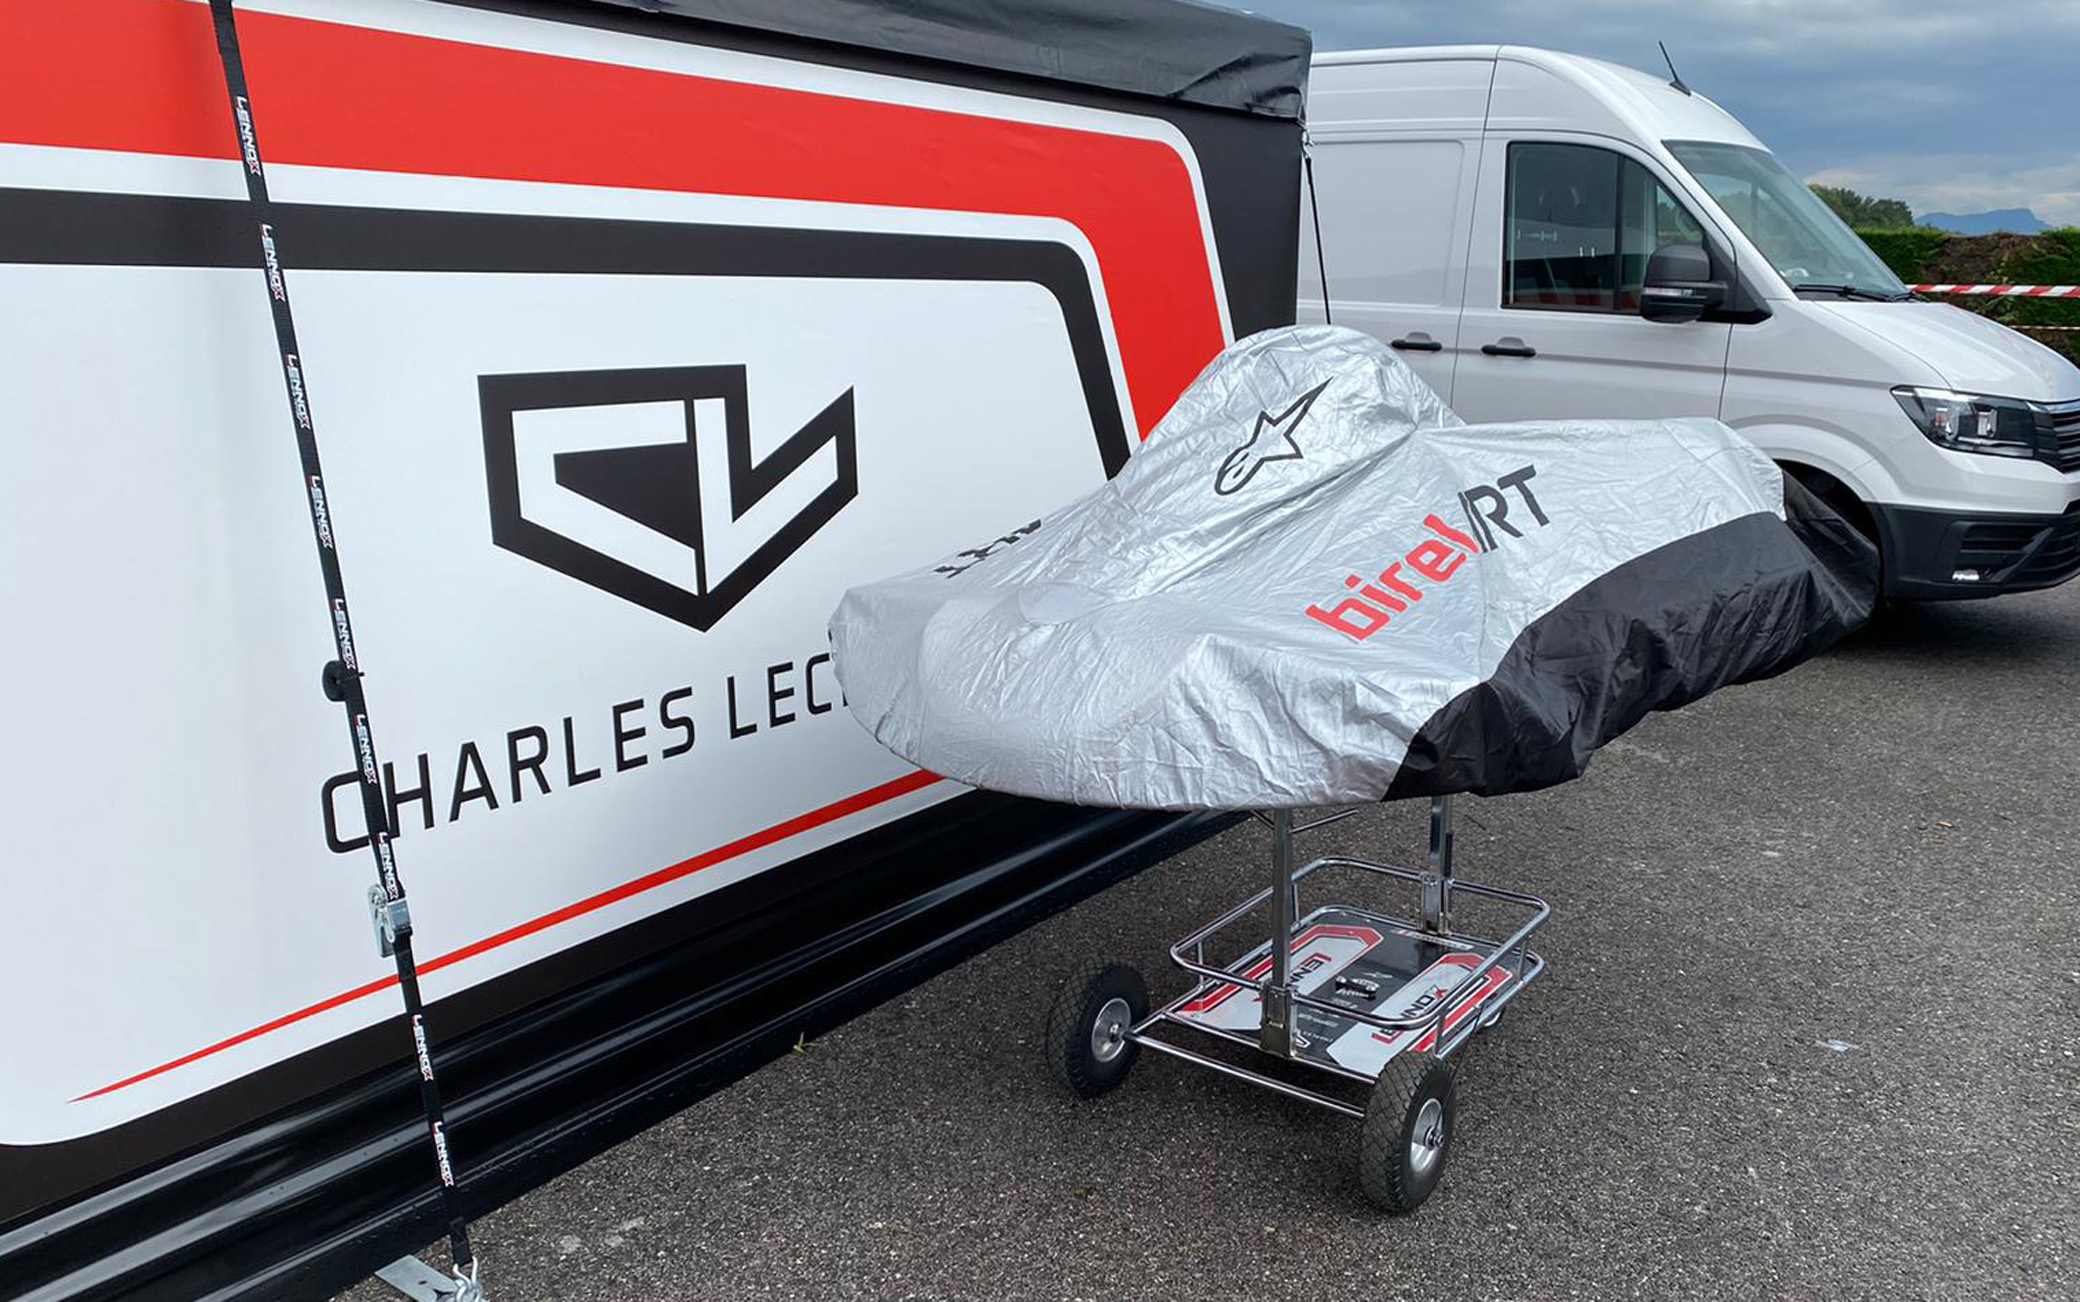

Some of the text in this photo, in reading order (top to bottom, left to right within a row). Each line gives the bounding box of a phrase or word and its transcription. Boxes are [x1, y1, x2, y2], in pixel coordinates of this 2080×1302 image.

[236, 96, 261, 177] LENNOX
[260, 223, 286, 303] LENNOX
[285, 354, 311, 430] LENNOX
[309, 475, 334, 549] LENNOX
[333, 599, 357, 670] LENNOX
[321, 652, 848, 854] CHARLES LEC
[354, 713, 378, 785] LENNOX
[377, 831, 399, 900] LENNOX
[411, 1014, 434, 1081] LENNOX
[432, 1121, 455, 1187] LENNOX
